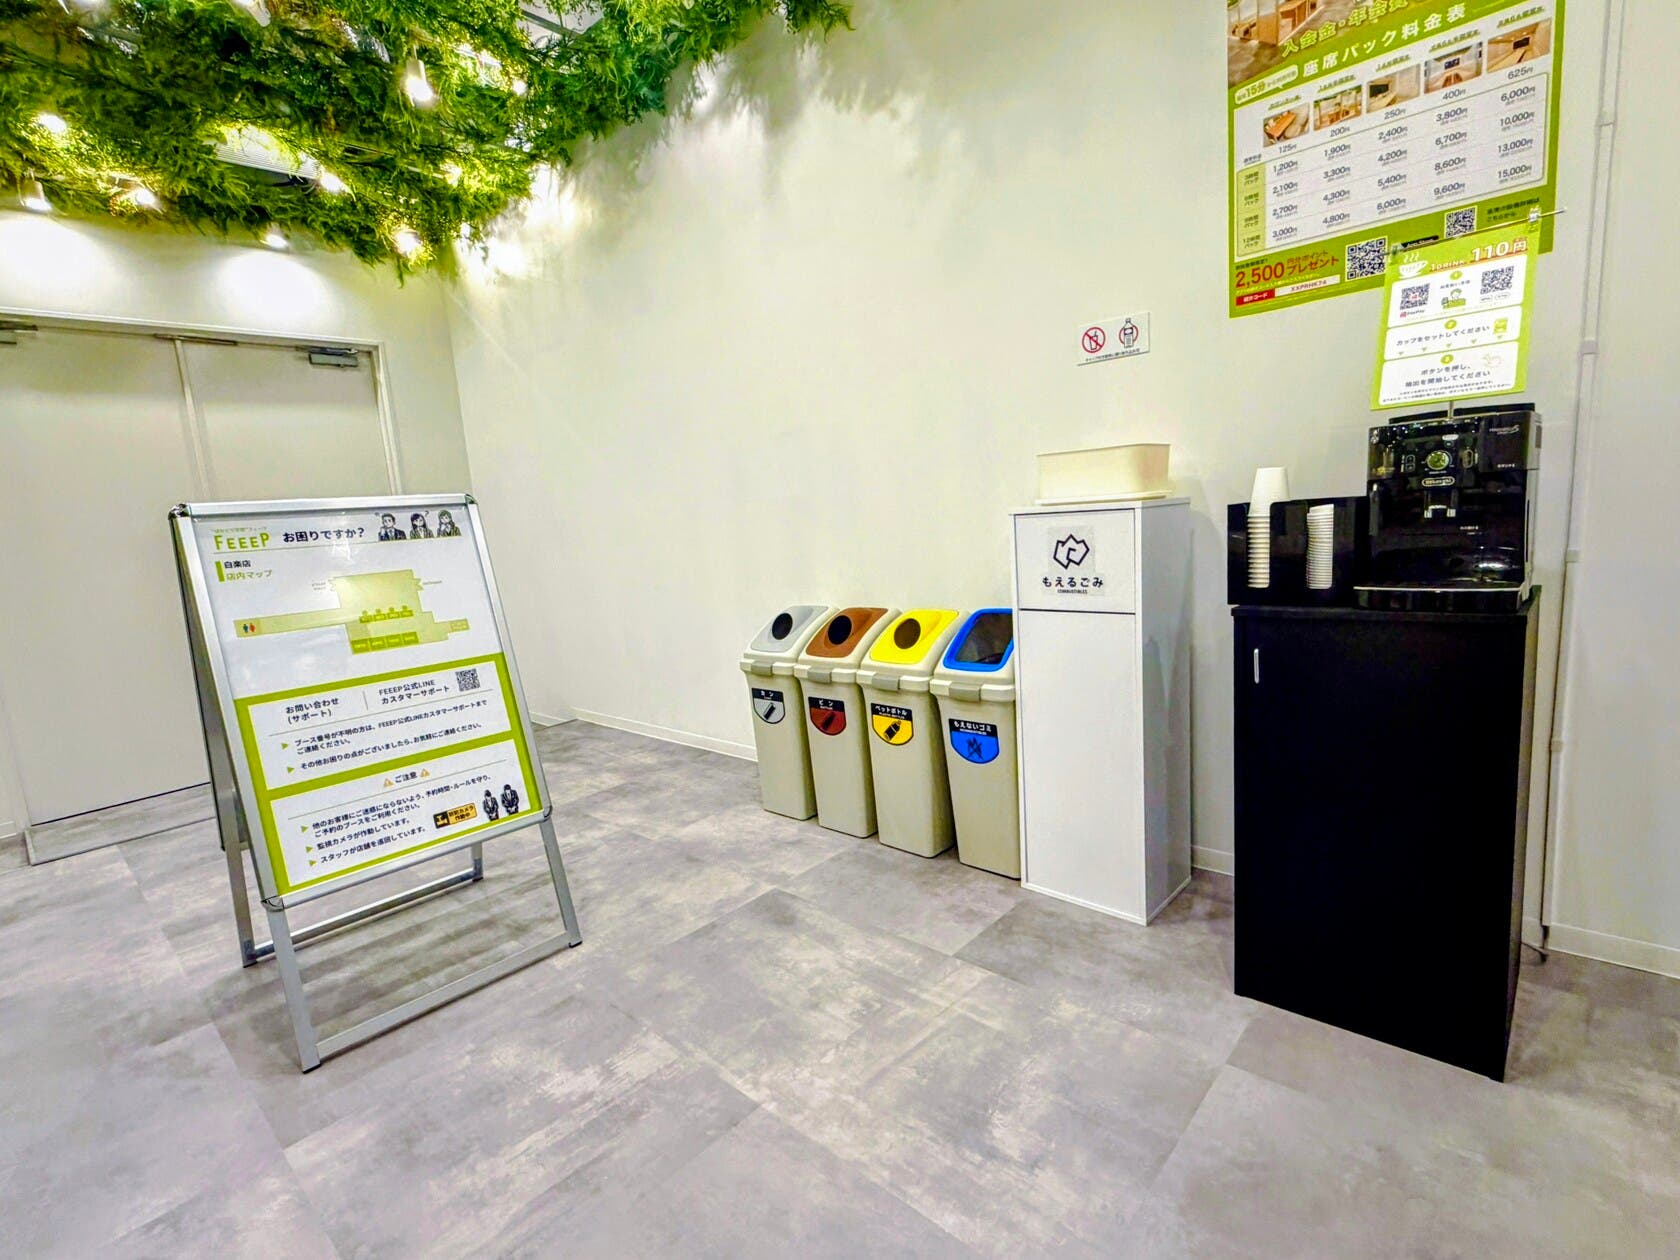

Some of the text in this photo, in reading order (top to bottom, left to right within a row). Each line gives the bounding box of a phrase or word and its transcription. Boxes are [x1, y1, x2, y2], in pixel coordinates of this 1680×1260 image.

[1303, 3, 1465, 77] 座席パック料金表
[1471, 239, 1528, 262] 110円
[1287, 256, 1340, 276] プレゼント
[1235, 262, 1285, 288] 2,500
[1396, 325, 1490, 346] カップをセットしてください
[283, 527, 365, 543] お困りですか？
[226, 569, 272, 581] 店内マップ
[1042, 576, 1104, 588] もえるごみ
[379, 680, 436, 695] FEEEP公式LINE
[382, 686, 449, 704] カスタマーサポート
[286, 698, 339, 714] お問い合わせ
[875, 705, 908, 716] ペットボトル
[954, 720, 992, 732] もえないゴミ
[395, 771, 417, 783] ご注意
